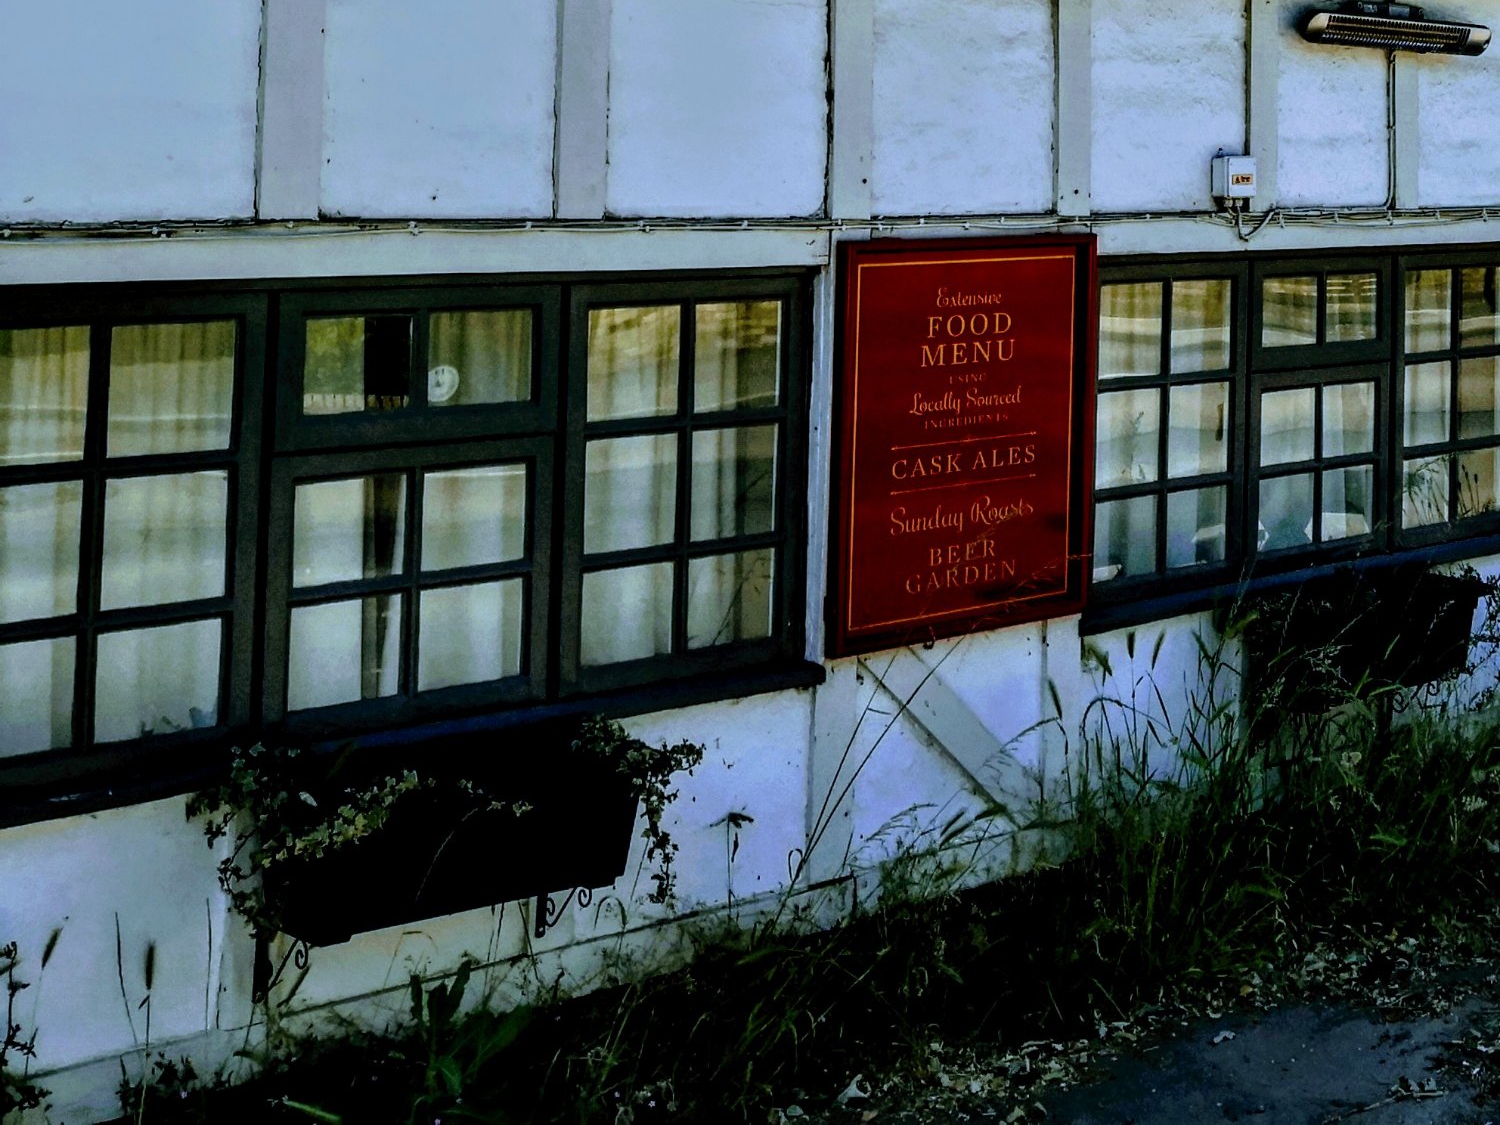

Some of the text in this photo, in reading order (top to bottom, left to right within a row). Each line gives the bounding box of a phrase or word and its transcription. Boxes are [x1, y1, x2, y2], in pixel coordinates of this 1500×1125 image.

[936, 287, 1002, 308] Extensive
[927, 312, 1012, 339] FOOD
[920, 339, 1016, 368] MENU
[909, 385, 1022, 416] Locally Sourced
[891, 445, 1037, 480] CASK ALES
[890, 495, 1034, 536] Sunday Roasts
[928, 538, 997, 567] BEER
[905, 559, 1016, 595] GARDEN
